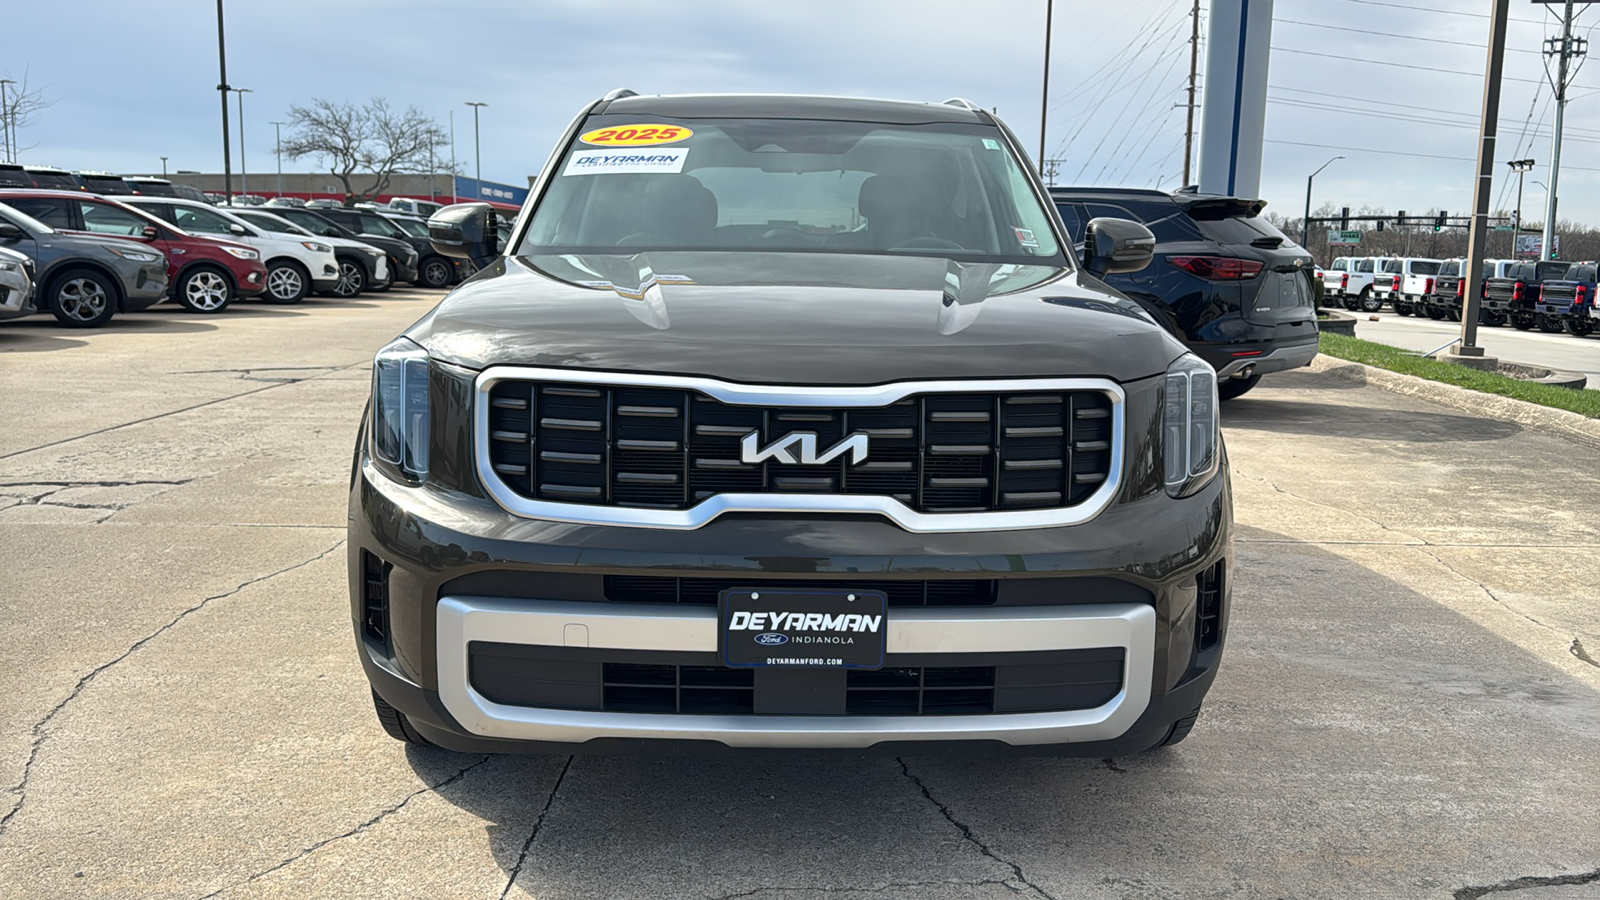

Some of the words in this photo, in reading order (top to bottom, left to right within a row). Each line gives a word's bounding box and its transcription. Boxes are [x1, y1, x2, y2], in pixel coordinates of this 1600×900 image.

[591, 128, 682, 142] 2025
[576, 155, 679, 165] DEYARMAN
[741, 430, 869, 465] KIA
[729, 611, 882, 633] DEYARMAN
[760, 634, 783, 644] Ford
[791, 635, 855, 645] INDIANOLA
[766, 657, 843, 666] DEYARMANFORD.COM
